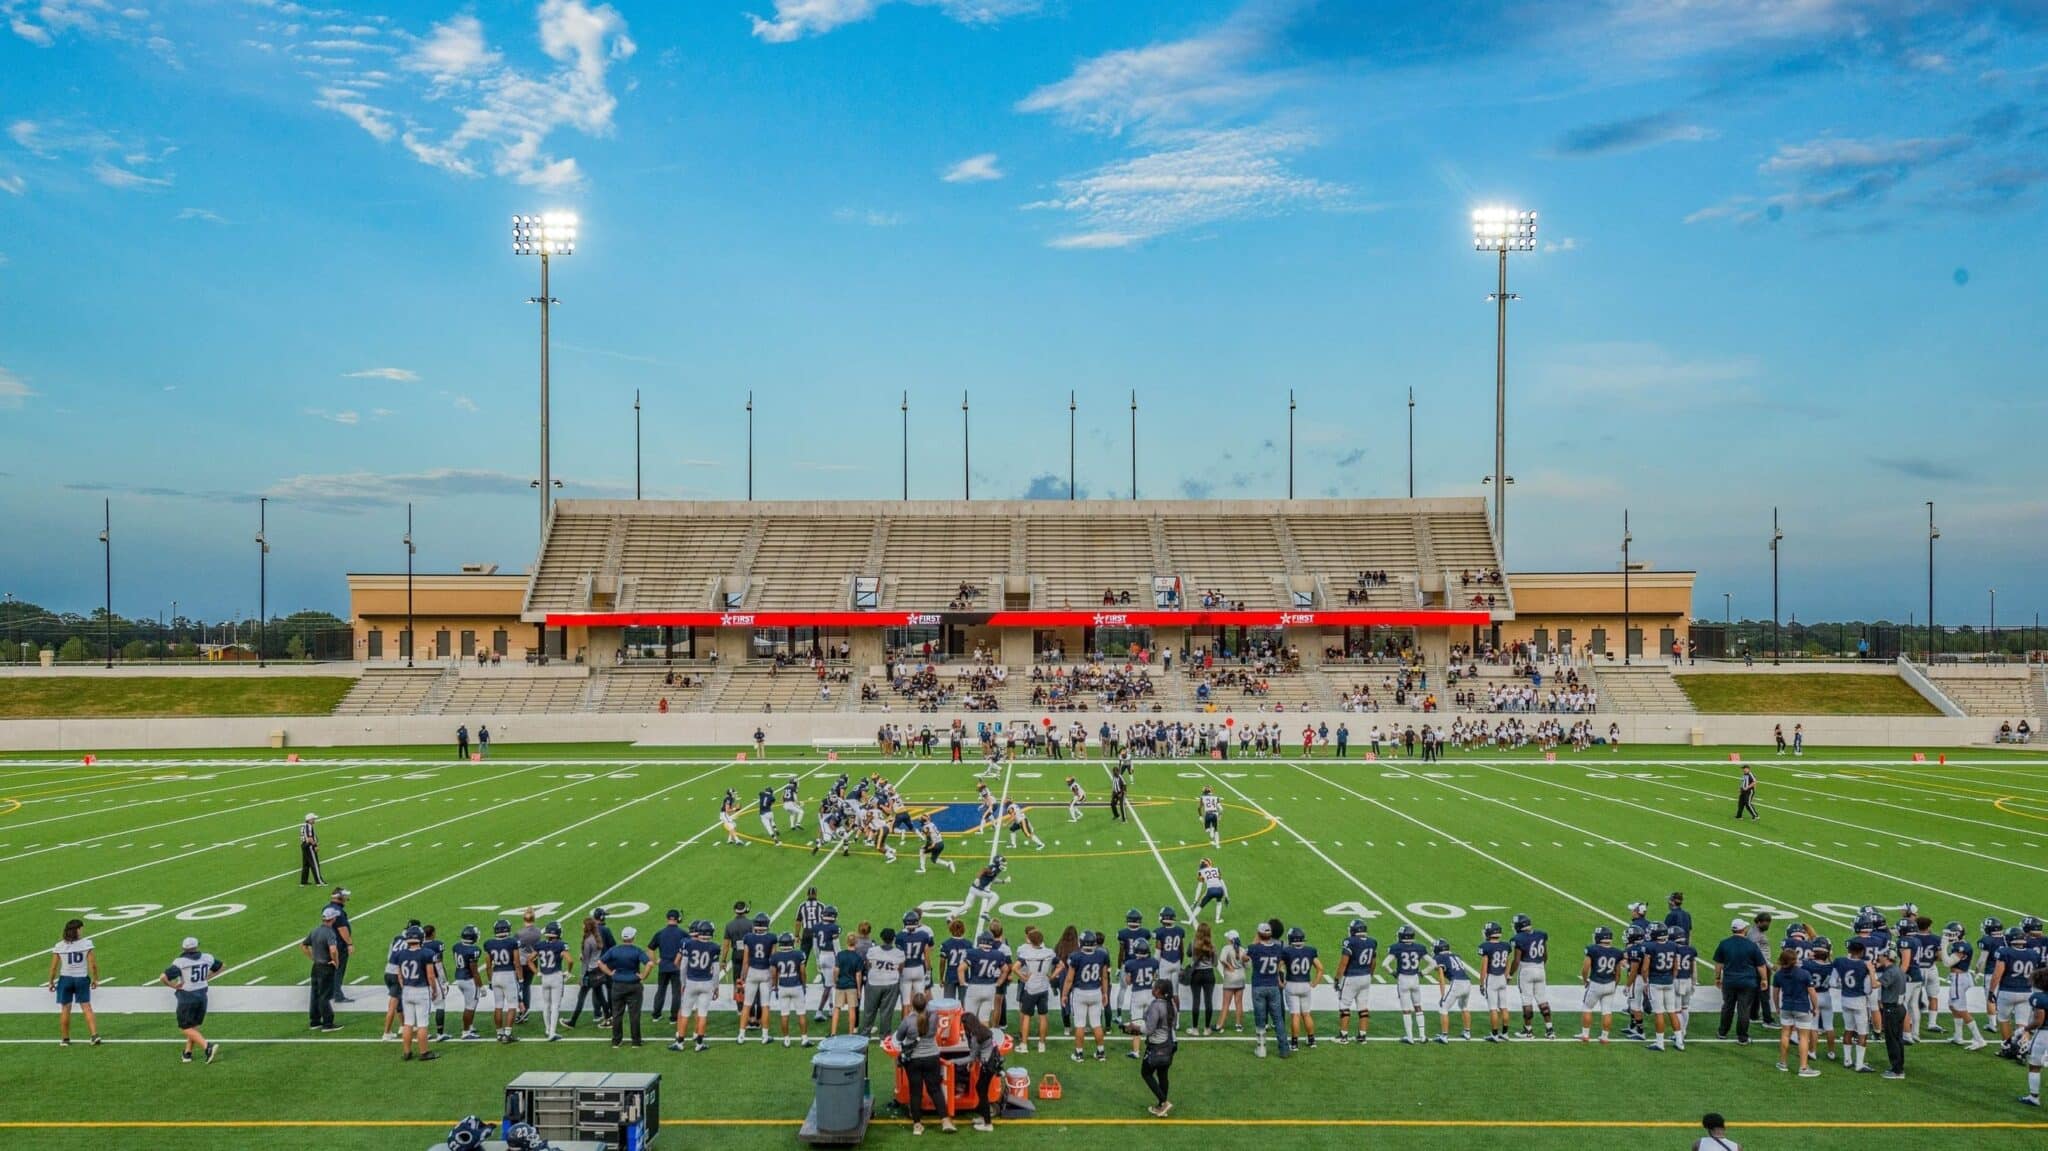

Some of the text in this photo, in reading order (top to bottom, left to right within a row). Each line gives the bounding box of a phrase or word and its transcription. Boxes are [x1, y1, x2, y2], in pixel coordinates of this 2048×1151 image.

[83, 903, 247, 920] 30
[498, 902, 650, 919] 40
[917, 901, 1054, 918] 50
[1323, 901, 1467, 919] 40
[818, 930, 826, 947] 2
[1164, 935, 1181, 952] 80
[491, 948, 510, 966] 20
[754, 943, 765, 959] 8
[906, 942, 923, 959] 17
[1359, 947, 1373, 966] 61
[1529, 939, 1545, 959] 66
[539, 949, 556, 968] 32
[689, 949, 710, 969] 30
[1259, 956, 1278, 974] 75
[1291, 957, 1310, 975] 60
[1400, 951, 1419, 970] 33
[1492, 950, 1508, 968] 88
[1597, 956, 1616, 974] 99
[1655, 951, 1675, 970] 35
[1677, 954, 1690, 970] 16
[191, 963, 209, 983] 50
[401, 959, 420, 979] 62
[777, 961, 797, 978] 22
[978, 959, 996, 978] 76
[1081, 963, 1100, 982] 68
[1136, 966, 1153, 986] 45
[2011, 960, 2033, 978] 90
[1844, 970, 1856, 988] 6
[939, 1016, 949, 1028] G
